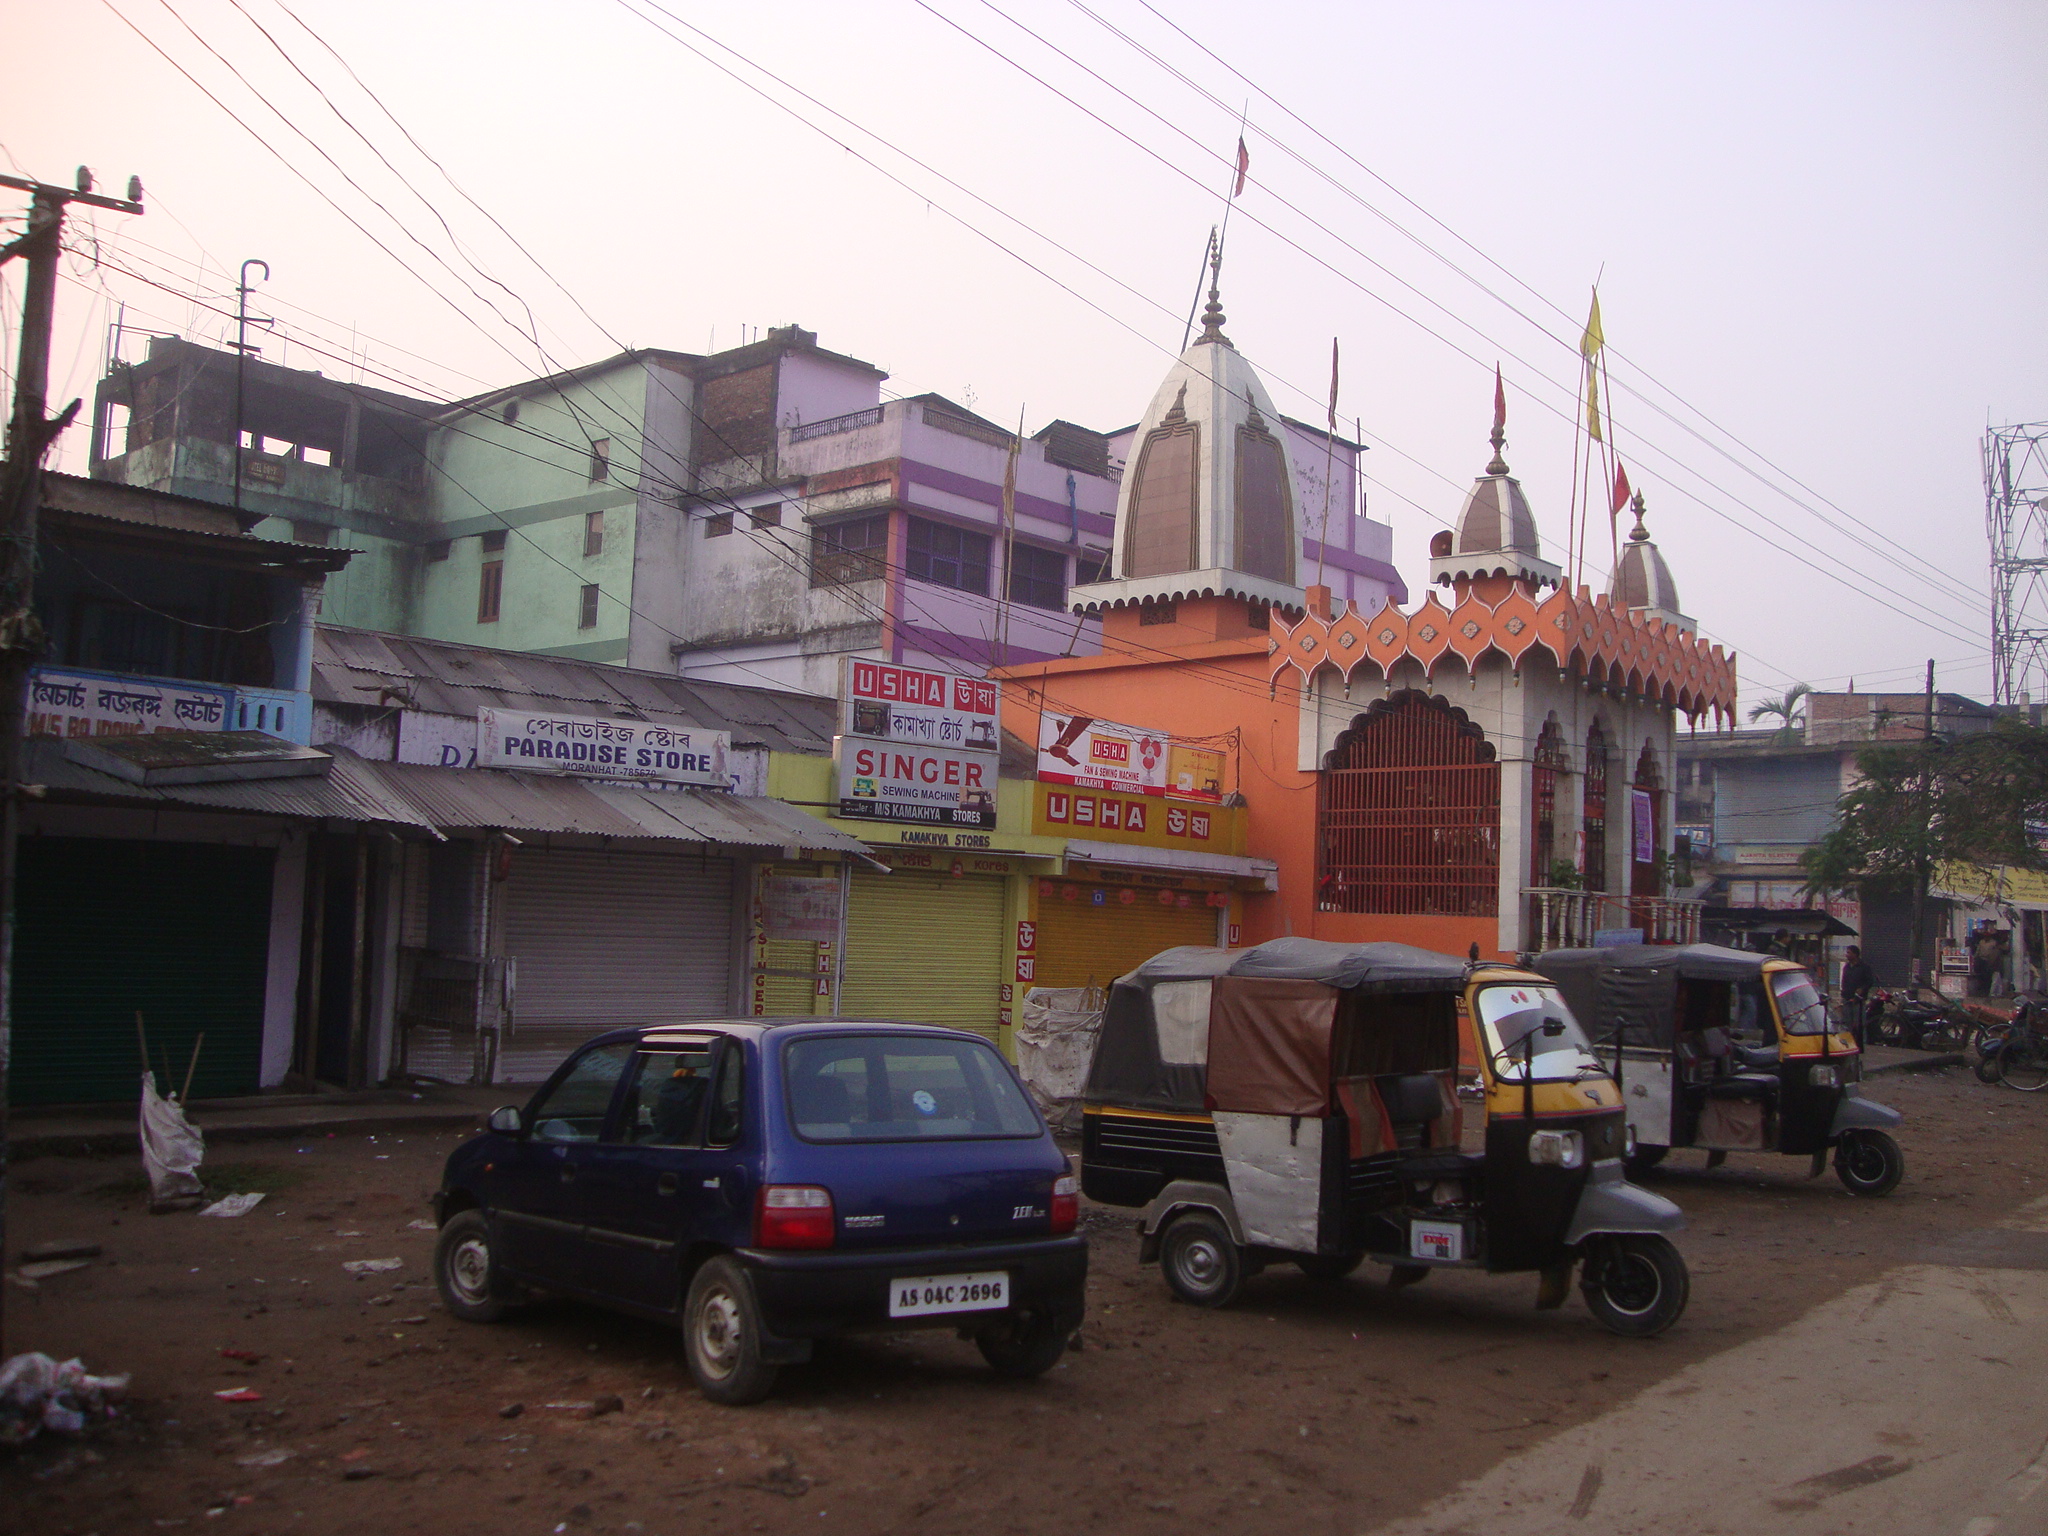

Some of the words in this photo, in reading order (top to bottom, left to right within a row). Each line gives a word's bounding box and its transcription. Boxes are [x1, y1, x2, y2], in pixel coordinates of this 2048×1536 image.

[859, 669, 941, 703] USHA
[956, 680, 994, 710] উষা
[505, 737, 627, 766] PARADISE
[637, 748, 711, 772] STORE
[1094, 742, 1127, 760] USHA
[562, 762, 617, 776] MORANHAT
[856, 749, 983, 787] SINGER
[1084, 765, 1094, 776] FAN
[1099, 768, 1118, 779] SEWING
[1119, 770, 1140, 781] MACHINE
[882, 786, 919, 799] SEWING
[921, 789, 960, 802] MACHINE
[1074, 776, 1105, 789] KAMAKHYA
[1111, 781, 1145, 794] COMMERCIAL
[892, 804, 941, 820] KAMAKHYA
[952, 810, 981, 823] STORES
[1050, 796, 1144, 828] USHA
[1168, 809, 1209, 837] উষা
[901, 831, 949, 846] KAMAKHYA
[954, 833, 991, 847] STORES
[899, 1289, 918, 1307] AS
[924, 1286, 954, 1304] 04C
[960, 1283, 1002, 1302] 2696
